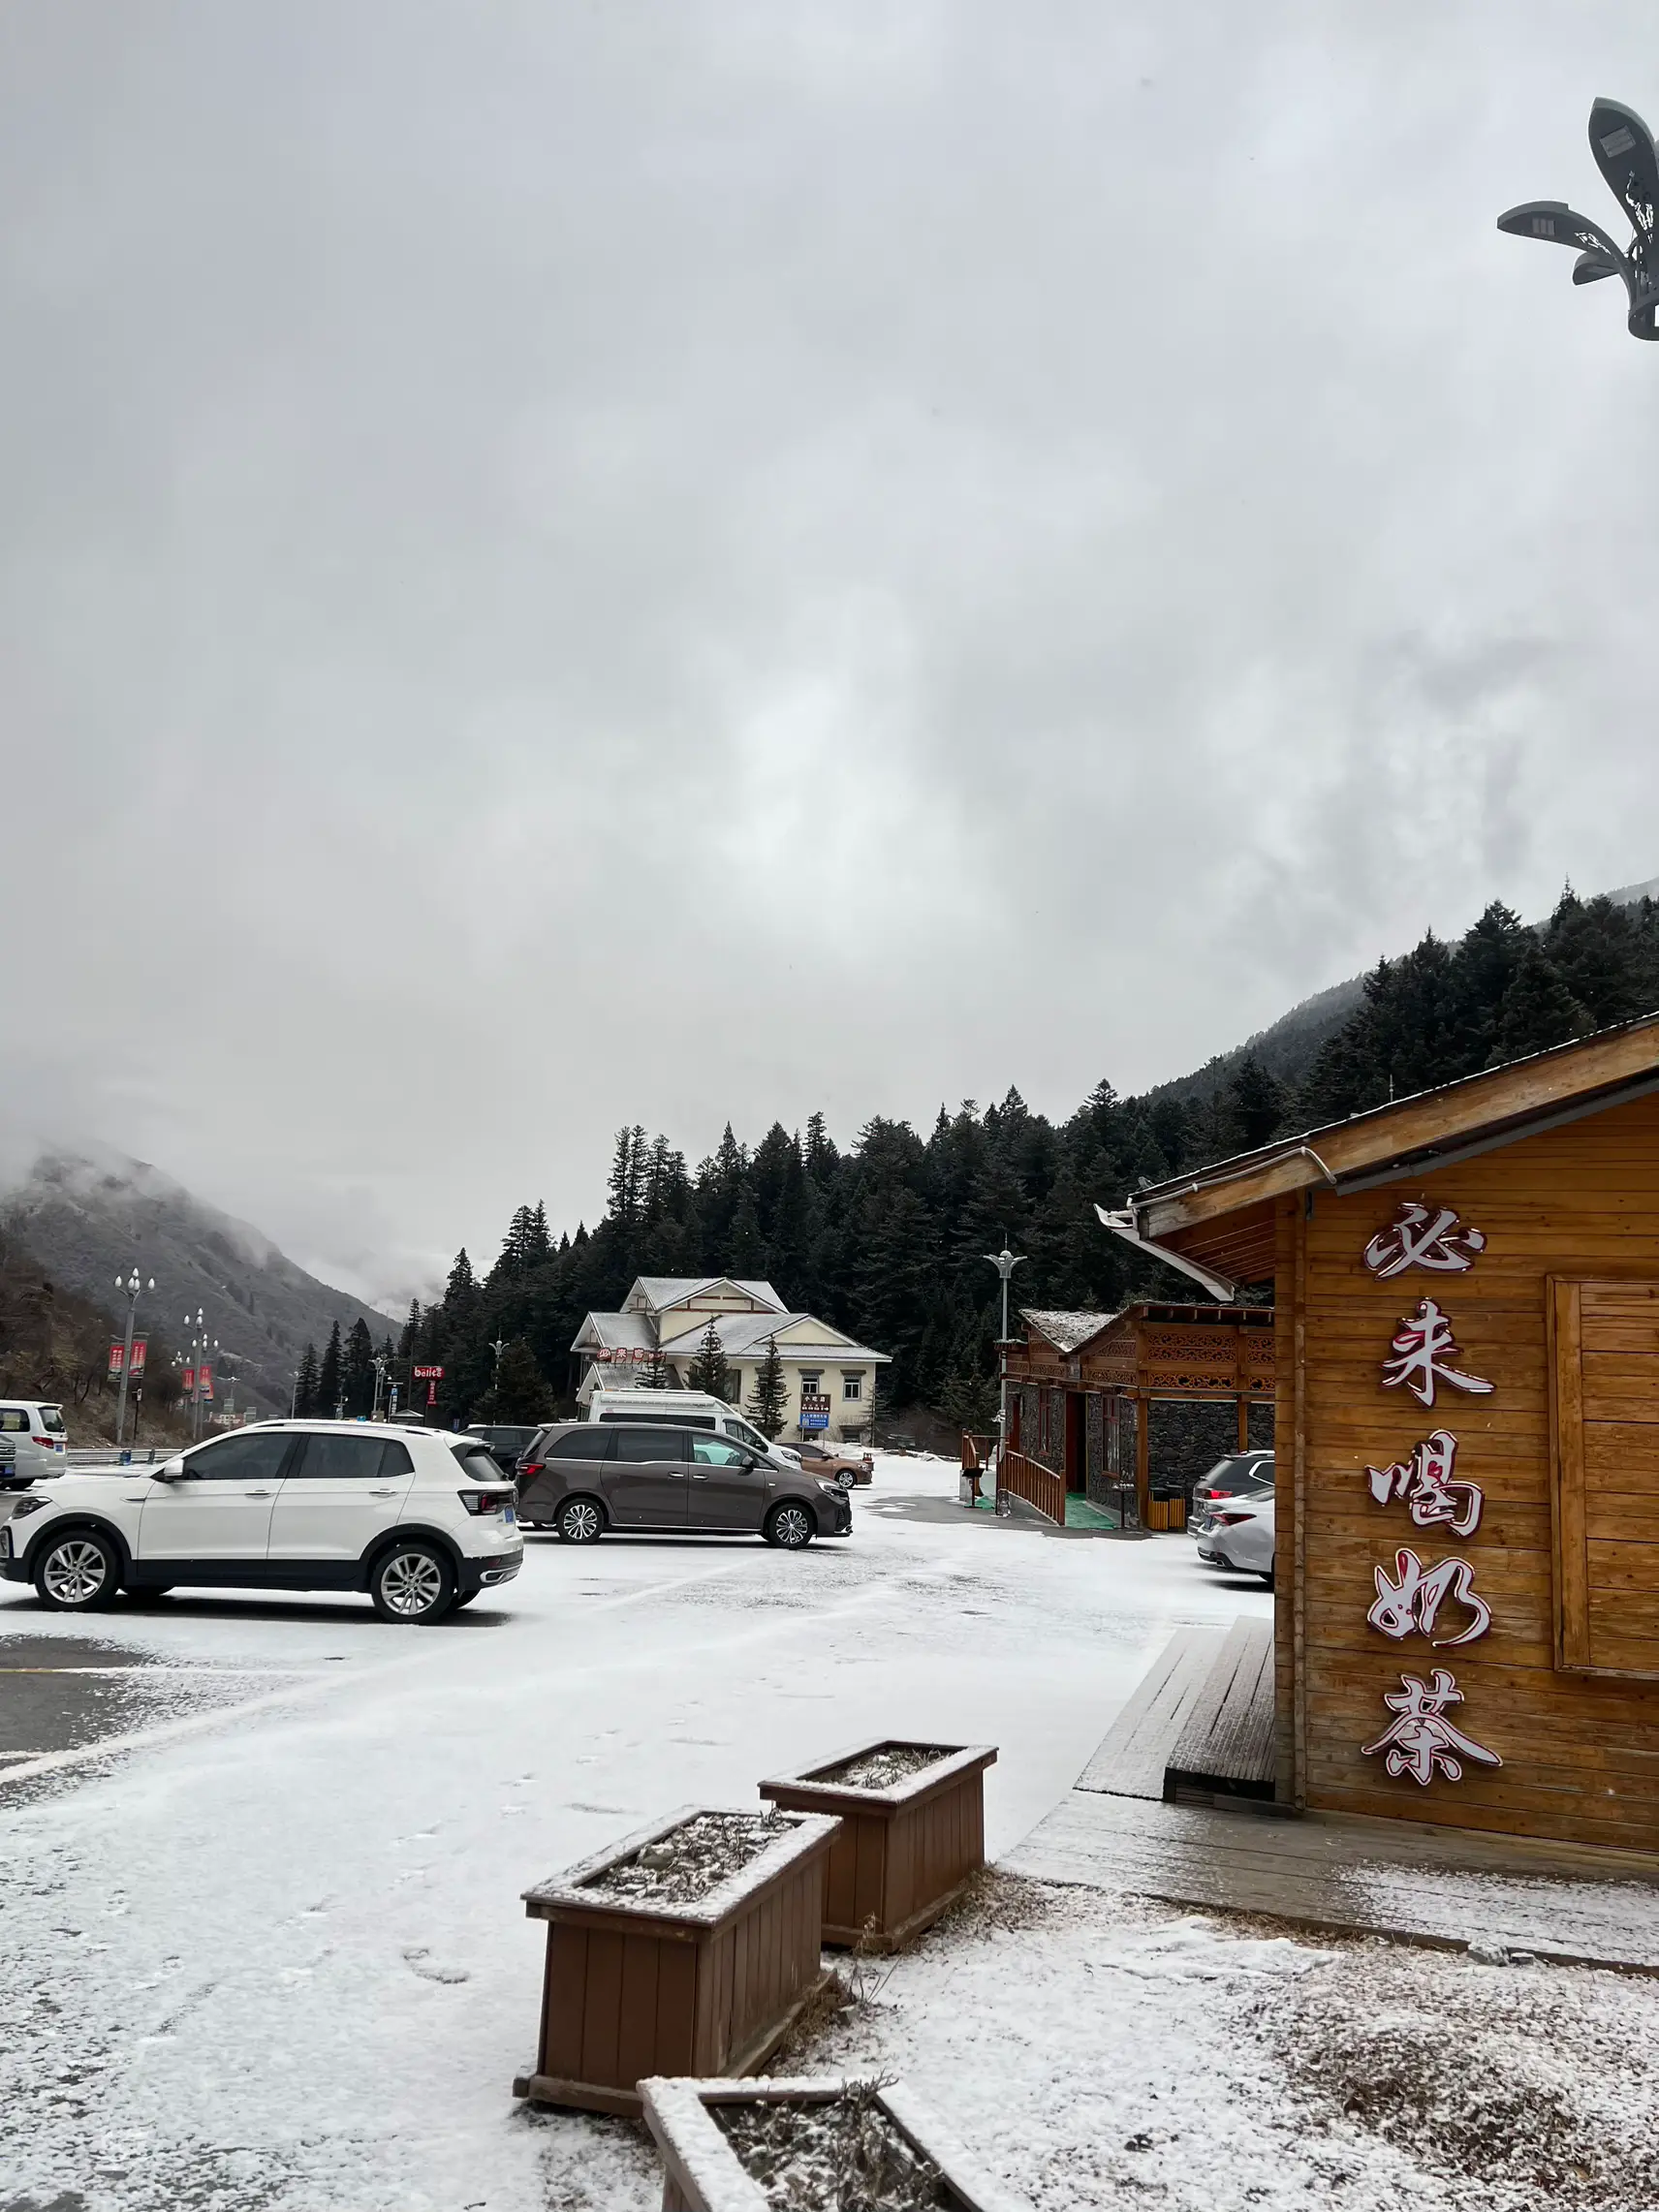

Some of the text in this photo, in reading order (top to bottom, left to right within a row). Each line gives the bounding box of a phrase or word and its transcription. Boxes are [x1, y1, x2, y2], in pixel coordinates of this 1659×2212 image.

[597, 1347, 643, 1359] 必来客
[1362, 1201, 1503, 1786] 必来喝奶茶
